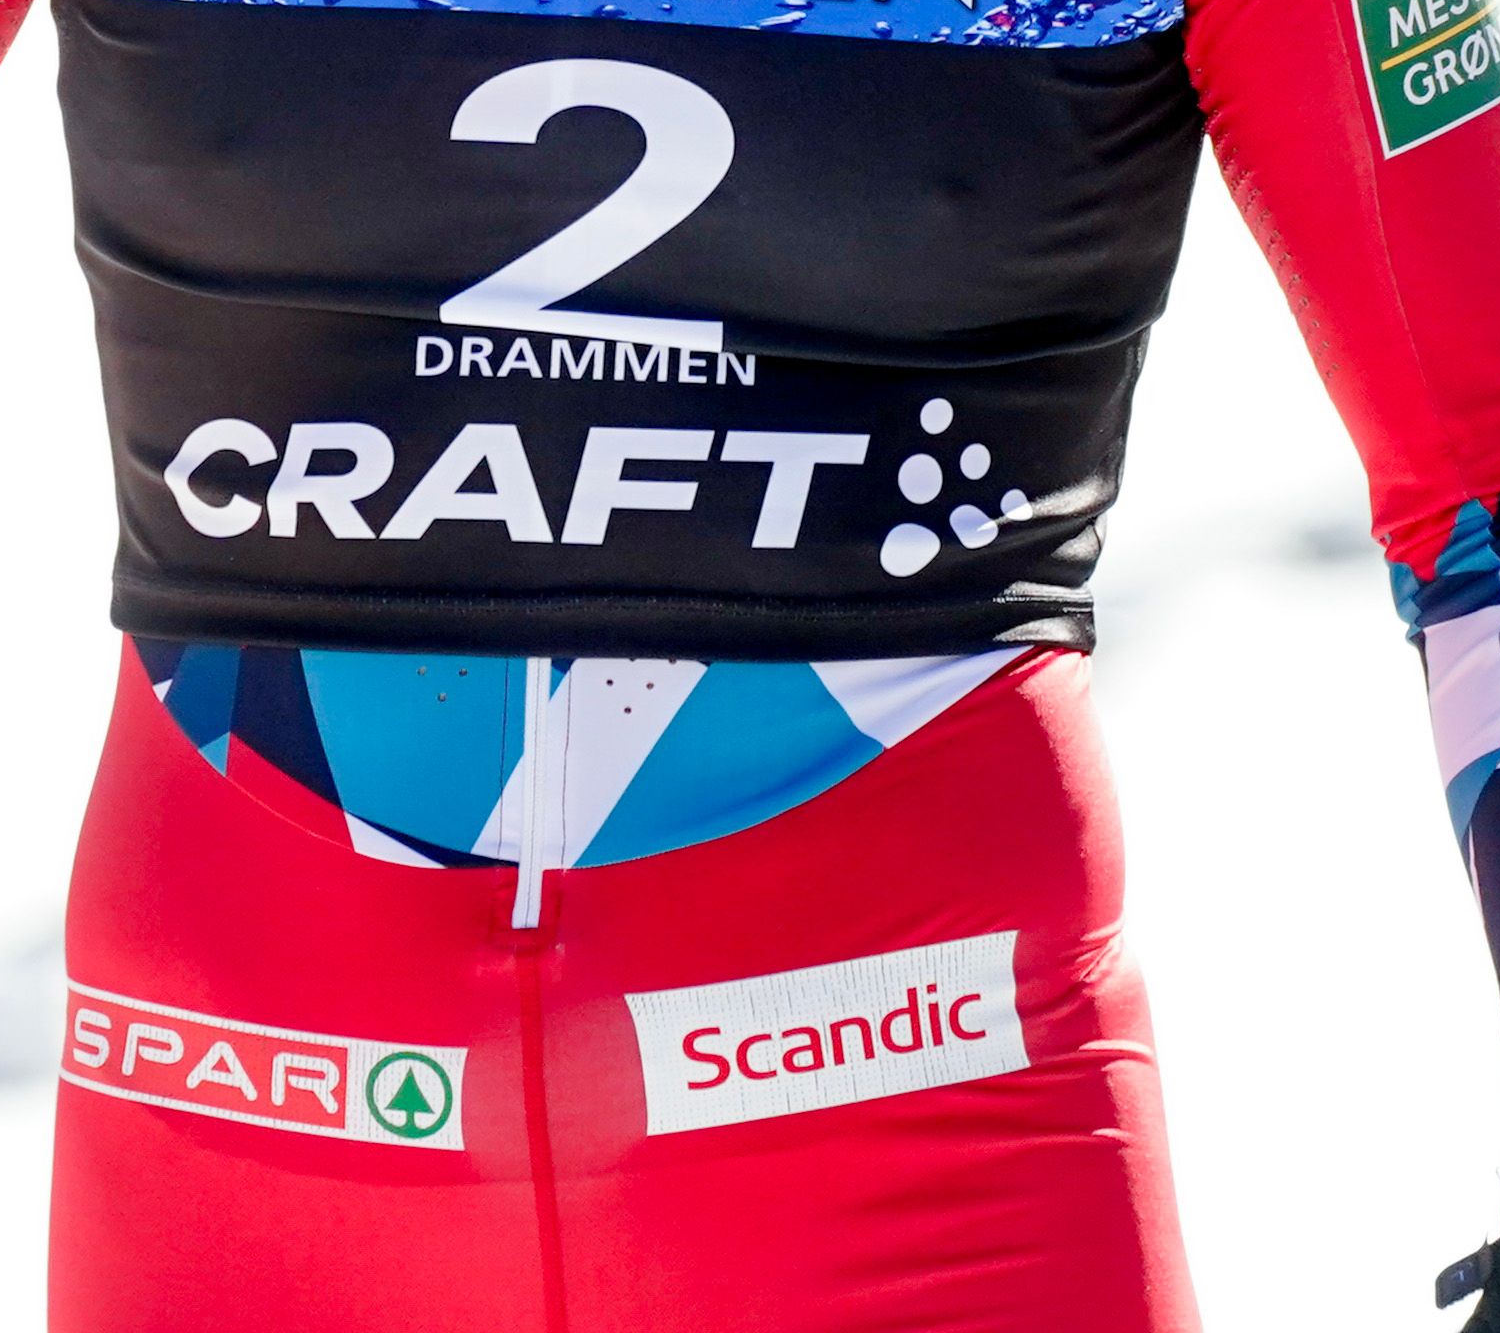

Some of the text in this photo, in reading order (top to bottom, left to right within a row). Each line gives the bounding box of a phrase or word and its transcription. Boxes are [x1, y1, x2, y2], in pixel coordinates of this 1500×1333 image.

[438, 58, 735, 352] 2
[415, 336, 757, 387] DRAMMEN
[163, 417, 870, 550] CRAFT
[72, 1015, 342, 1116] SPAR
[683, 983, 987, 1091] Scandic
